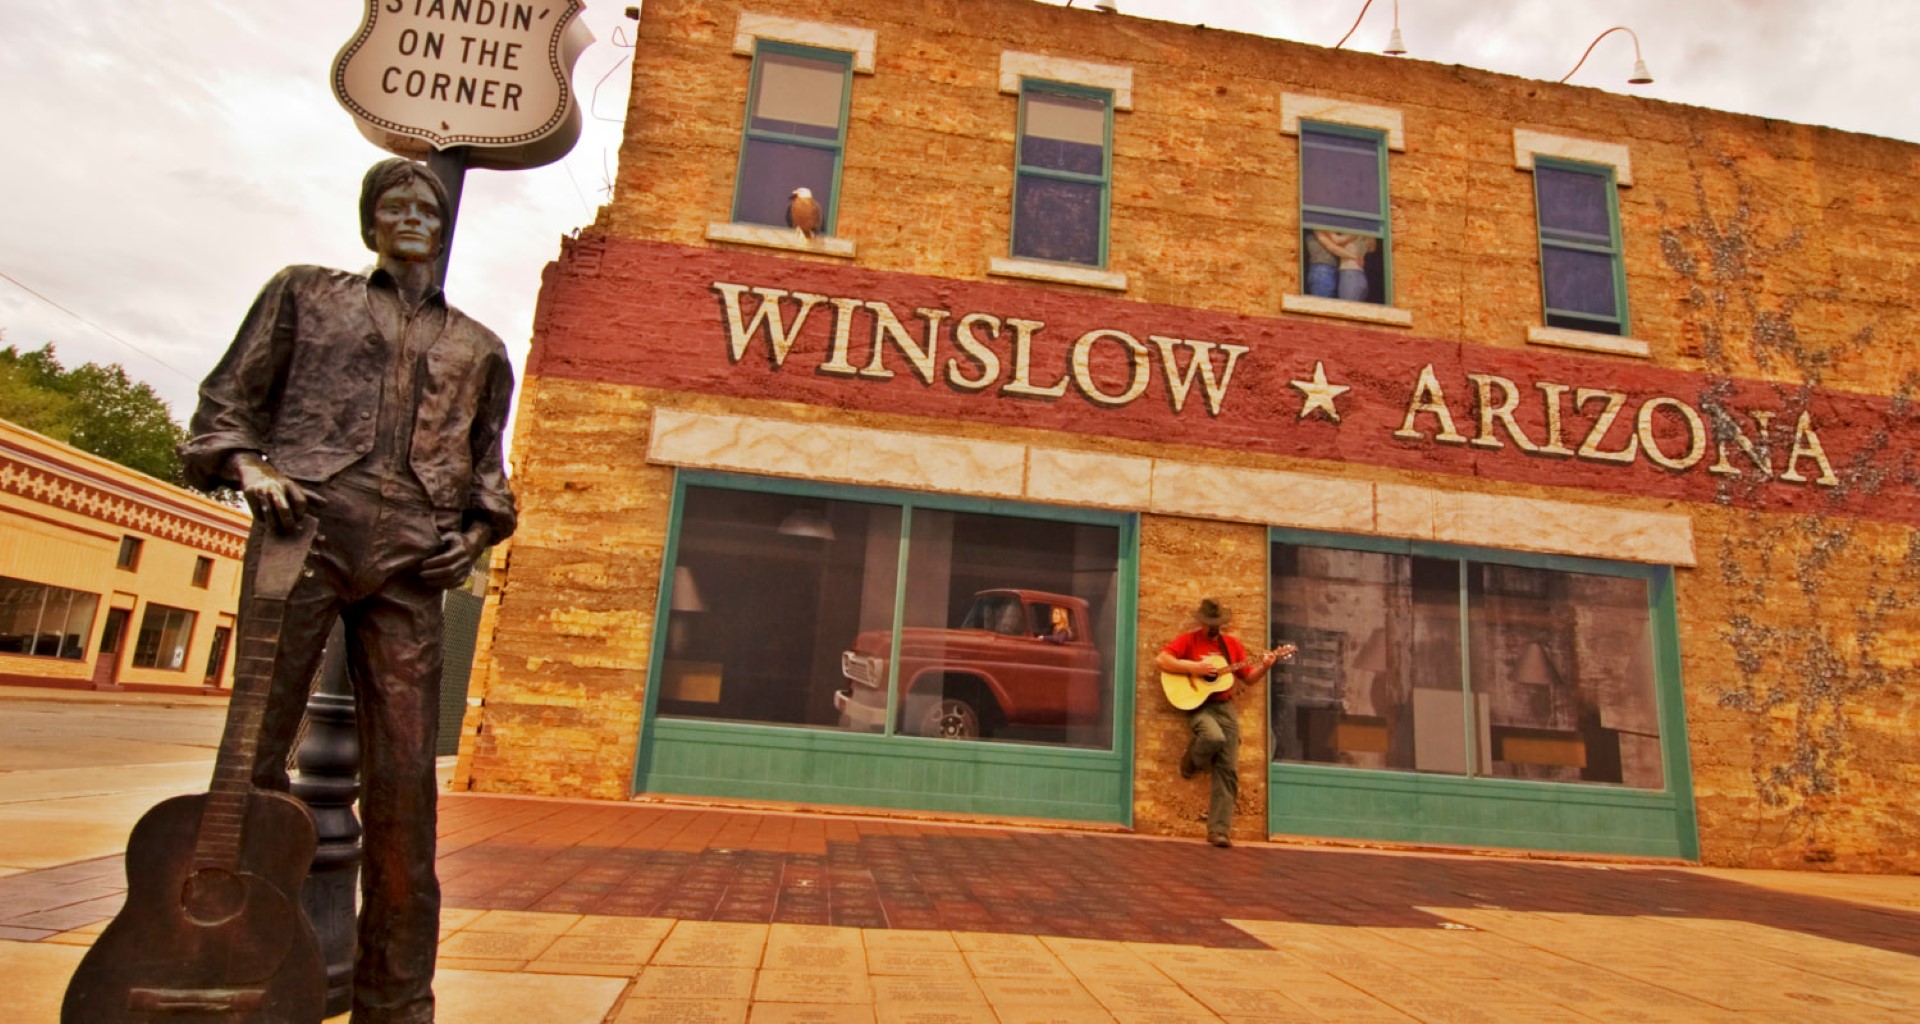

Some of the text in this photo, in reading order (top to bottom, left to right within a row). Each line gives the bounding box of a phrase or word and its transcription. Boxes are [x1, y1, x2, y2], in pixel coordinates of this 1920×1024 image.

[398, 29, 522, 70] ON THE
[381, 66, 523, 111] CORNER
[713, 281, 1840, 487] WINSLOW ARIZONA
